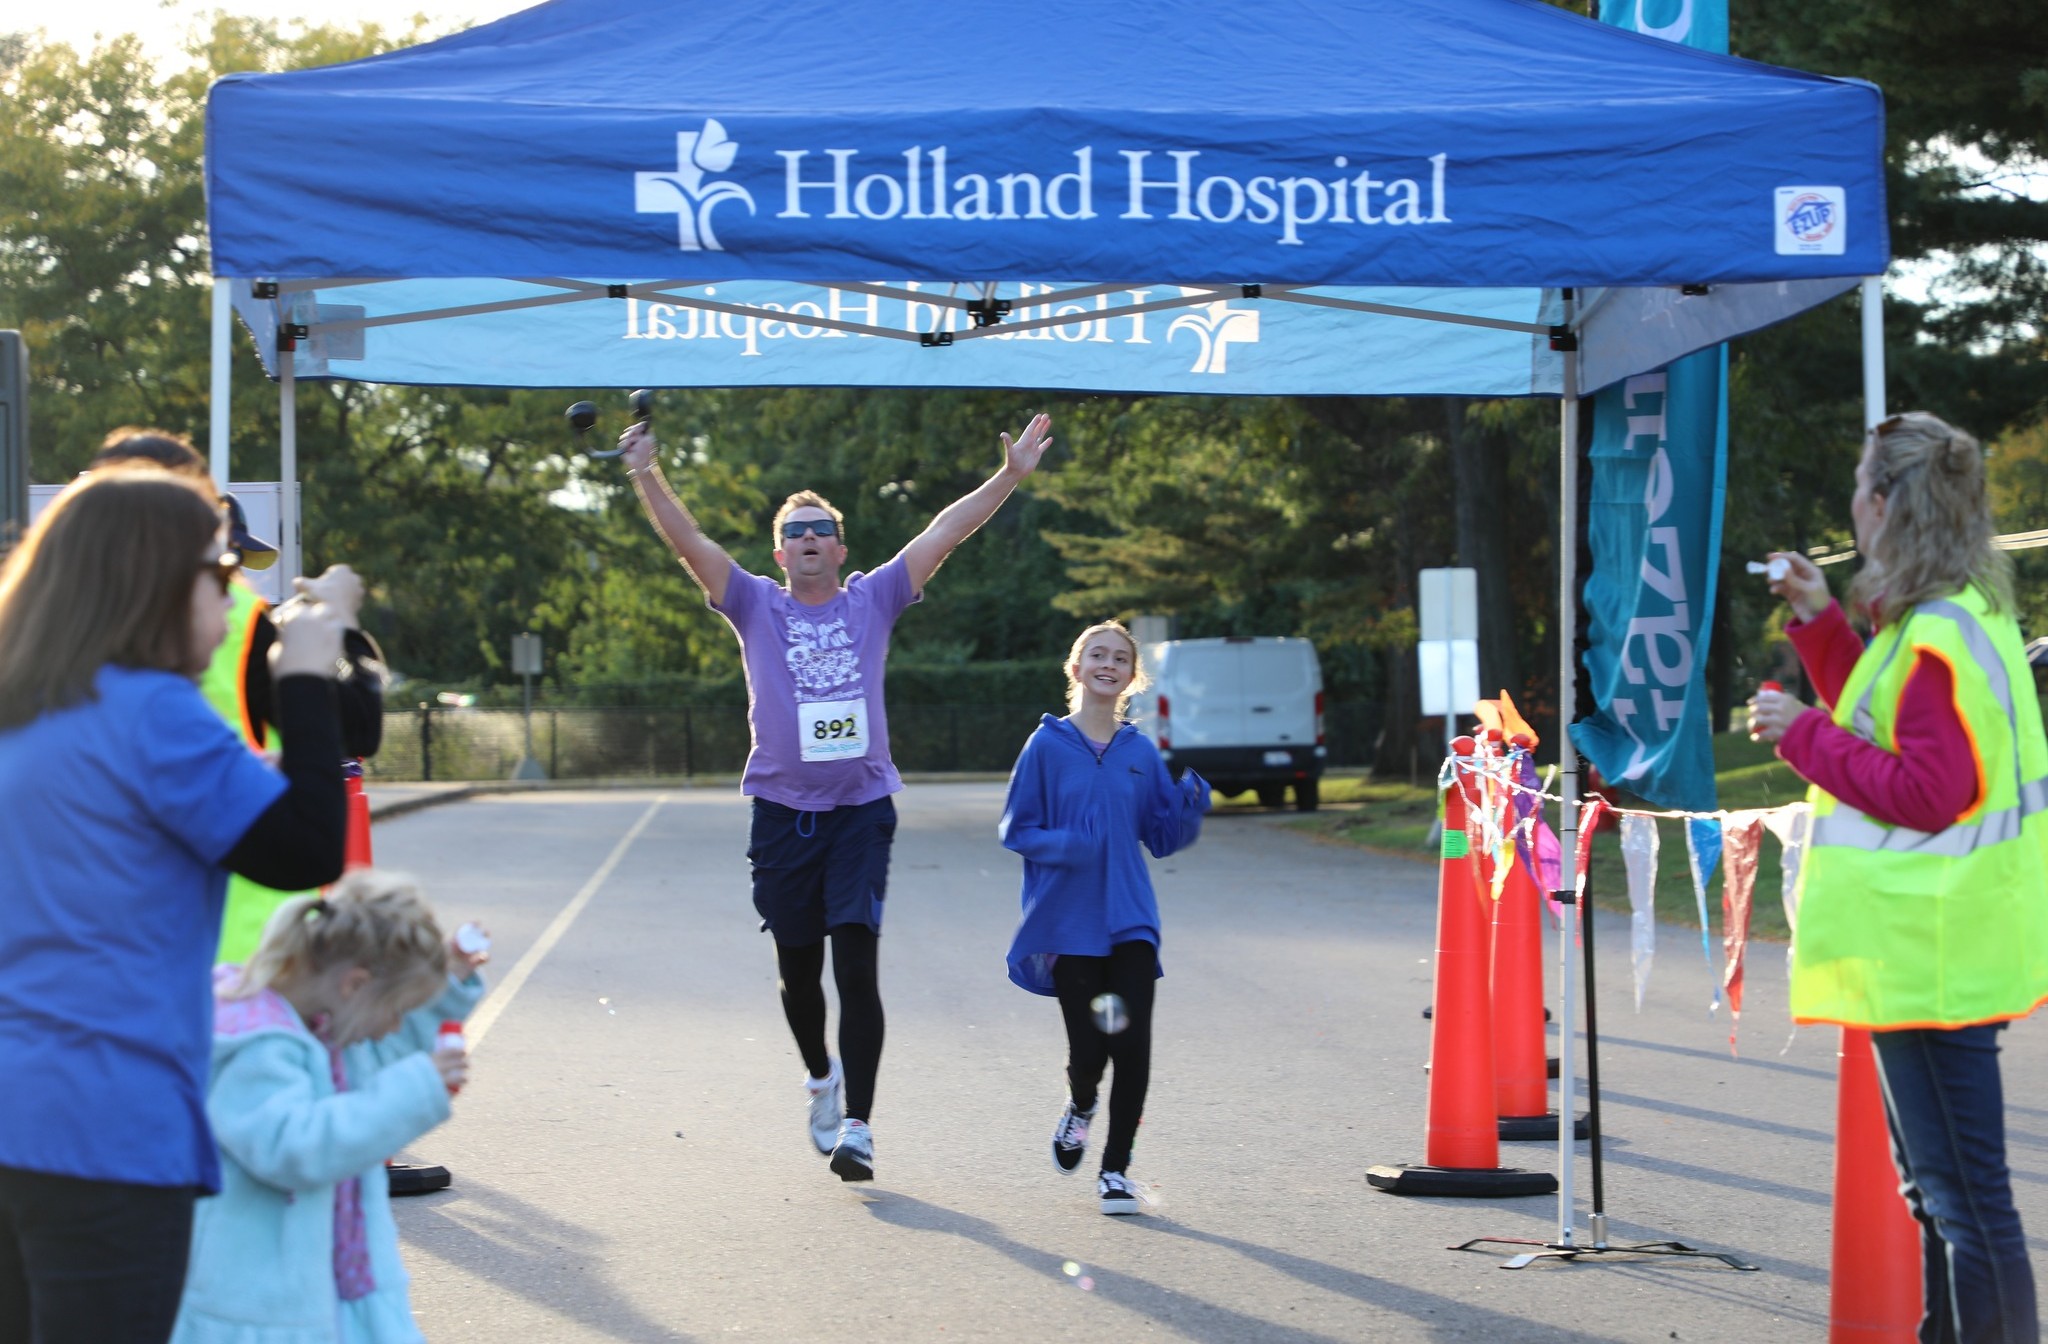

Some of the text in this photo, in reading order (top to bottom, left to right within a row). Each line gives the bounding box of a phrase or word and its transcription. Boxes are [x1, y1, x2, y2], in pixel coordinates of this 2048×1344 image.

[774, 144, 1453, 246] Holland Hospital
[814, 718, 856, 739] 892
